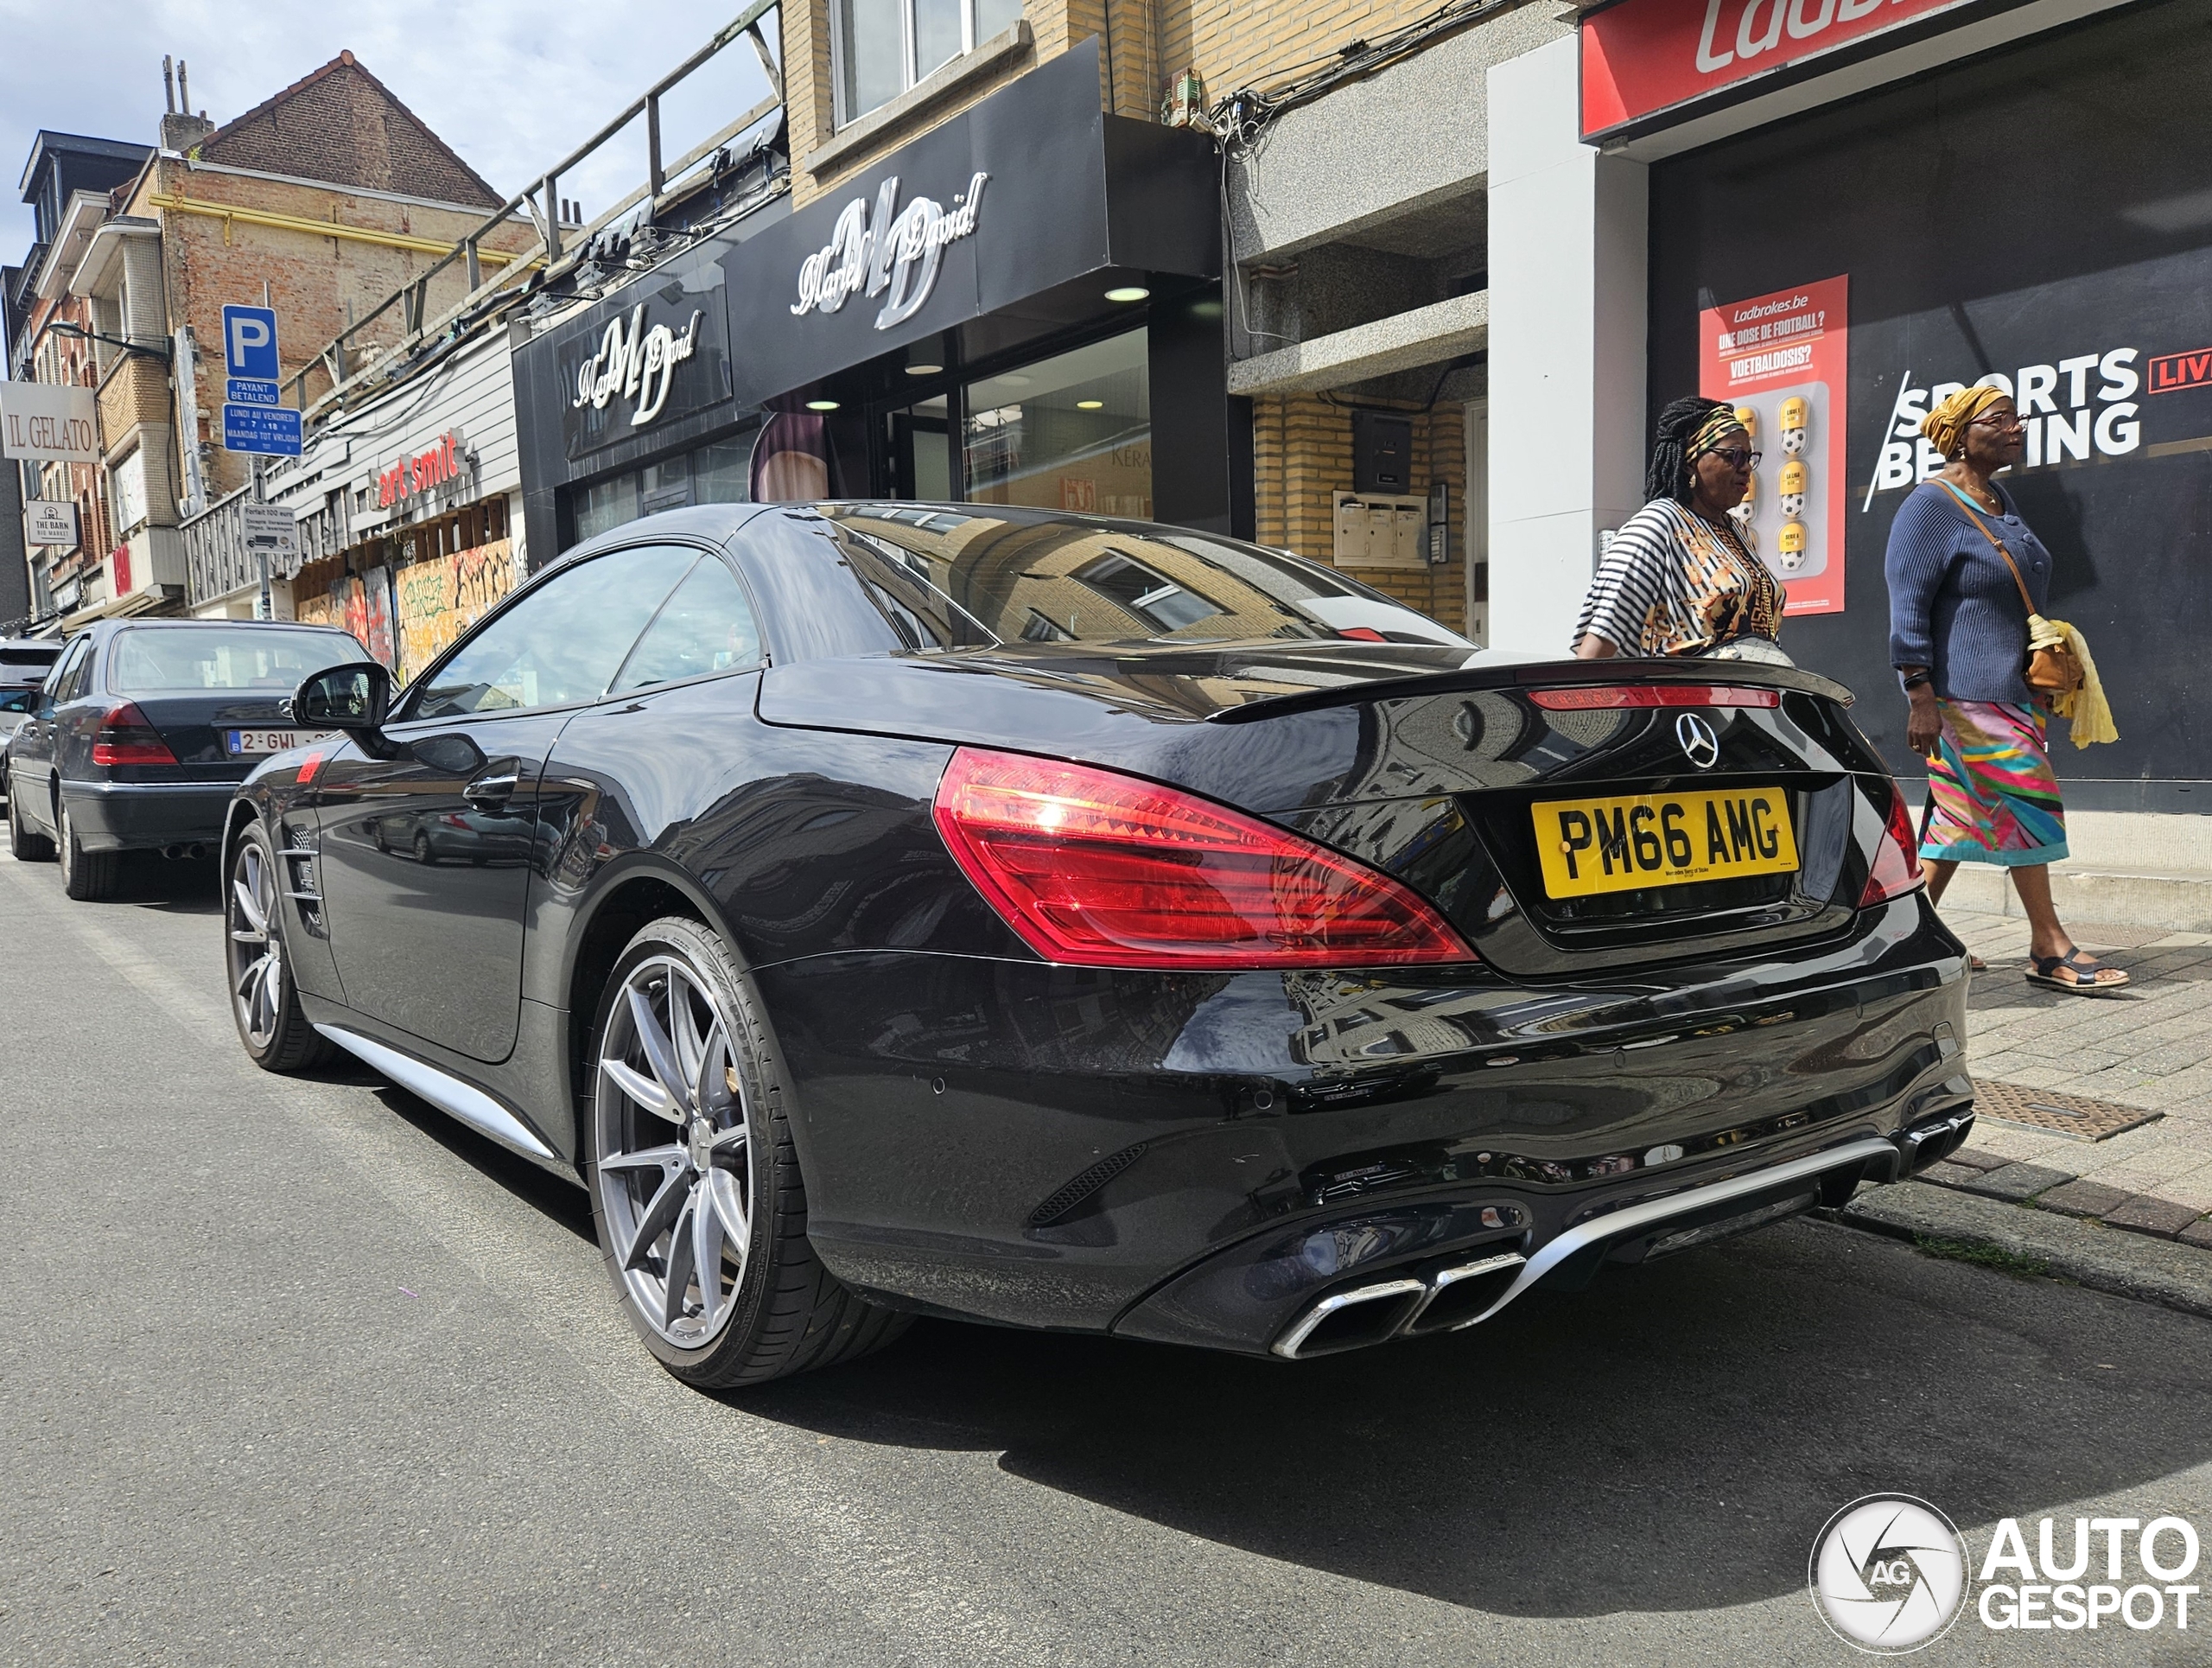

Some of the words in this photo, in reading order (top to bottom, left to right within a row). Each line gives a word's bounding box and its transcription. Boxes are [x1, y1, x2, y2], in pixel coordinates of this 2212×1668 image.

[1733, 295, 1808, 323] Ladbrokes.be
[231, 316, 270, 367] P
[1719, 332, 1736, 350] UNE
[1737, 326, 1760, 346] DOSE
[1760, 323, 1772, 341] DE
[1773, 312, 1817, 337] FOOTBALL
[1730, 344, 1812, 379] VOETBALDOSIS?
[2159, 353, 2212, 386] LIV
[231, 391, 276, 404] BETALEND
[236, 382, 269, 393] PAYANT
[1893, 347, 2139, 438] SRTS
[8, 414, 26, 448] IL
[29, 416, 92, 452] GELATO
[230, 409, 250, 418] LUNDI
[251, 411, 261, 419] AU
[263, 411, 296, 423] VENDREDI
[226, 429, 257, 439] MAANDAG
[259, 431, 271, 441] TOT
[273, 433, 300, 443] VRIJDAG
[1878, 402, 2140, 491] BEING
[378, 456, 408, 508] art
[411, 429, 459, 493] smit
[35, 520, 48, 530] THE
[49, 521, 69, 531] BARN
[232, 742, 240, 751] B
[1558, 803, 1692, 880] PM66
[1706, 798, 1779, 865] AMG
